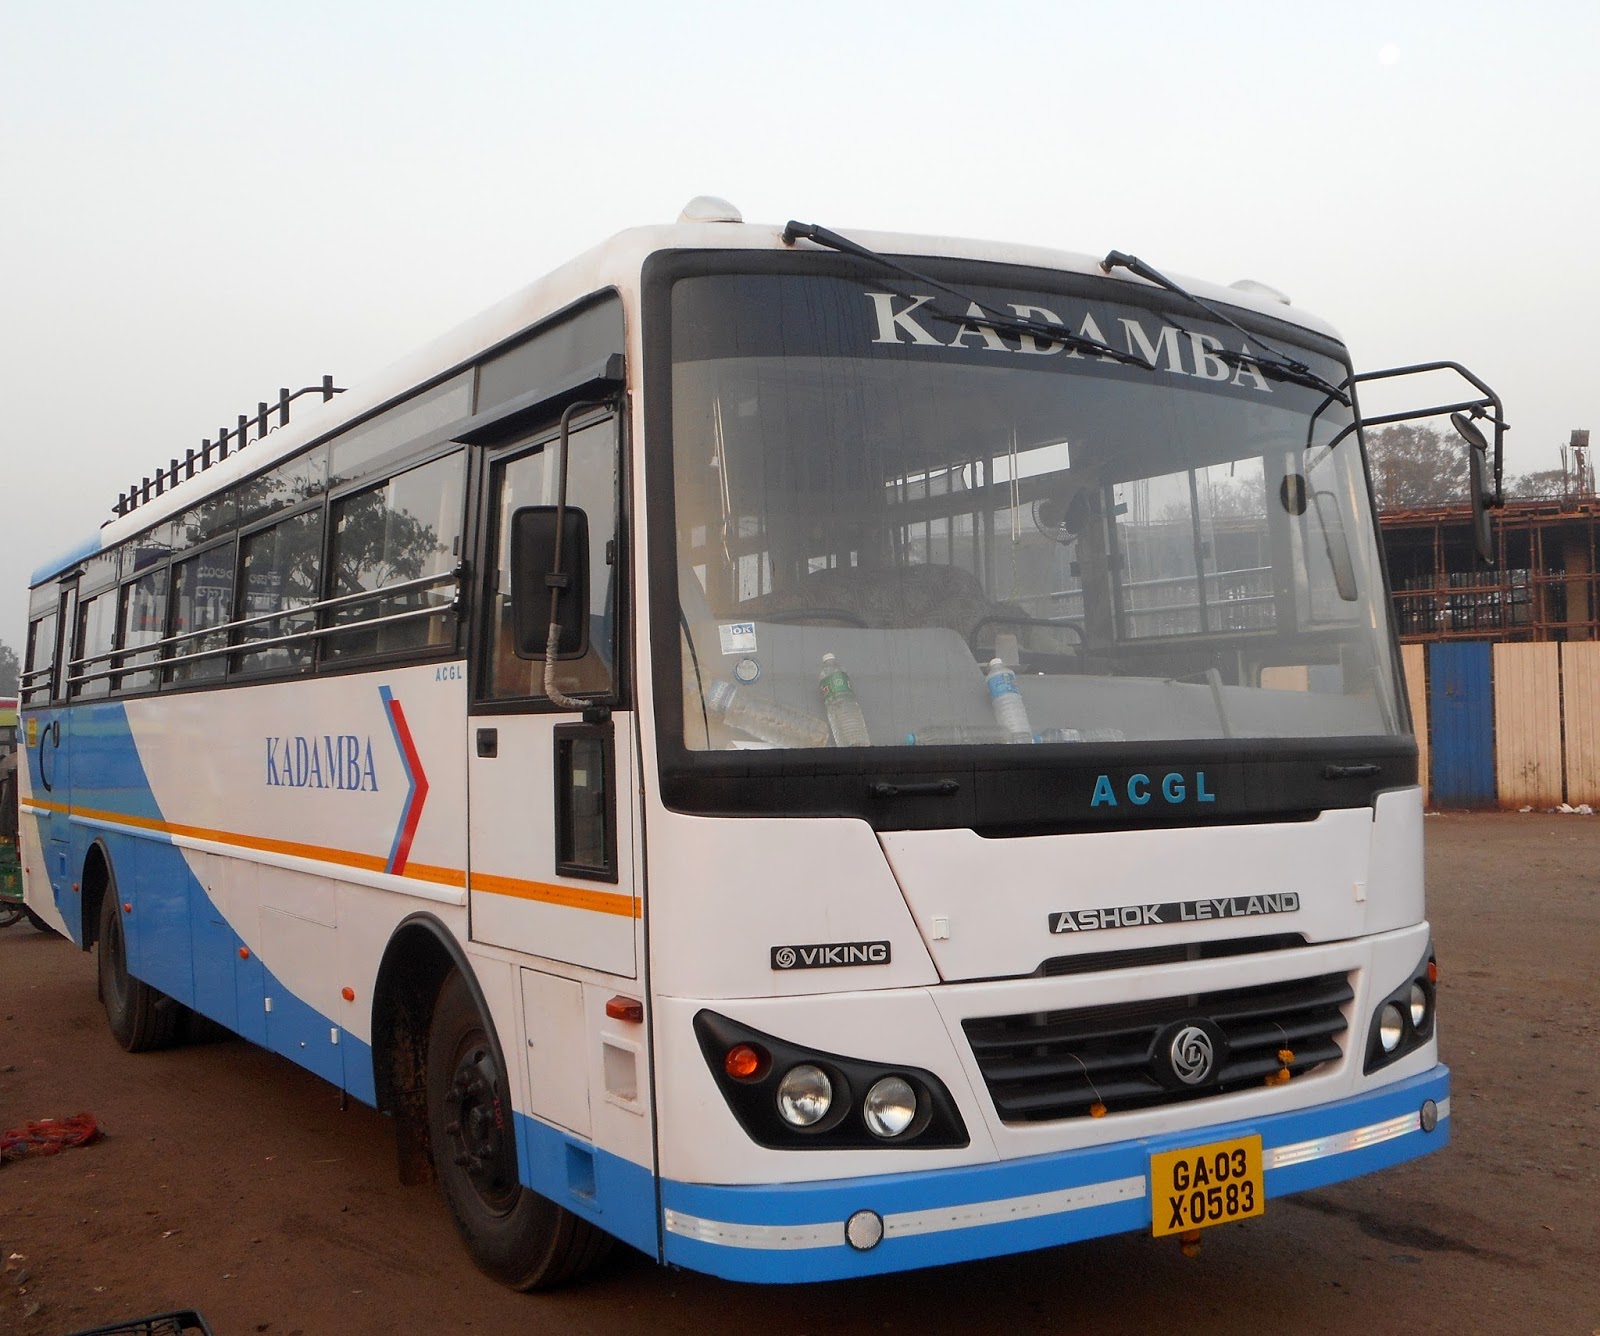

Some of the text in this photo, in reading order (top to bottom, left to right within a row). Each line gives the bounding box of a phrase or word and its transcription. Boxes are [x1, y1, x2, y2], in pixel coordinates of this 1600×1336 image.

[864, 292, 1274, 393] KADAMBA
[732, 626, 752, 635] OK
[435, 666, 462, 682] ACGL
[265, 735, 379, 792] KADAMBA
[1090, 771, 1216, 807] ACGL
[1055, 892, 1298, 933] ASHOK LEYLAND
[800, 944, 887, 965] VIKING
